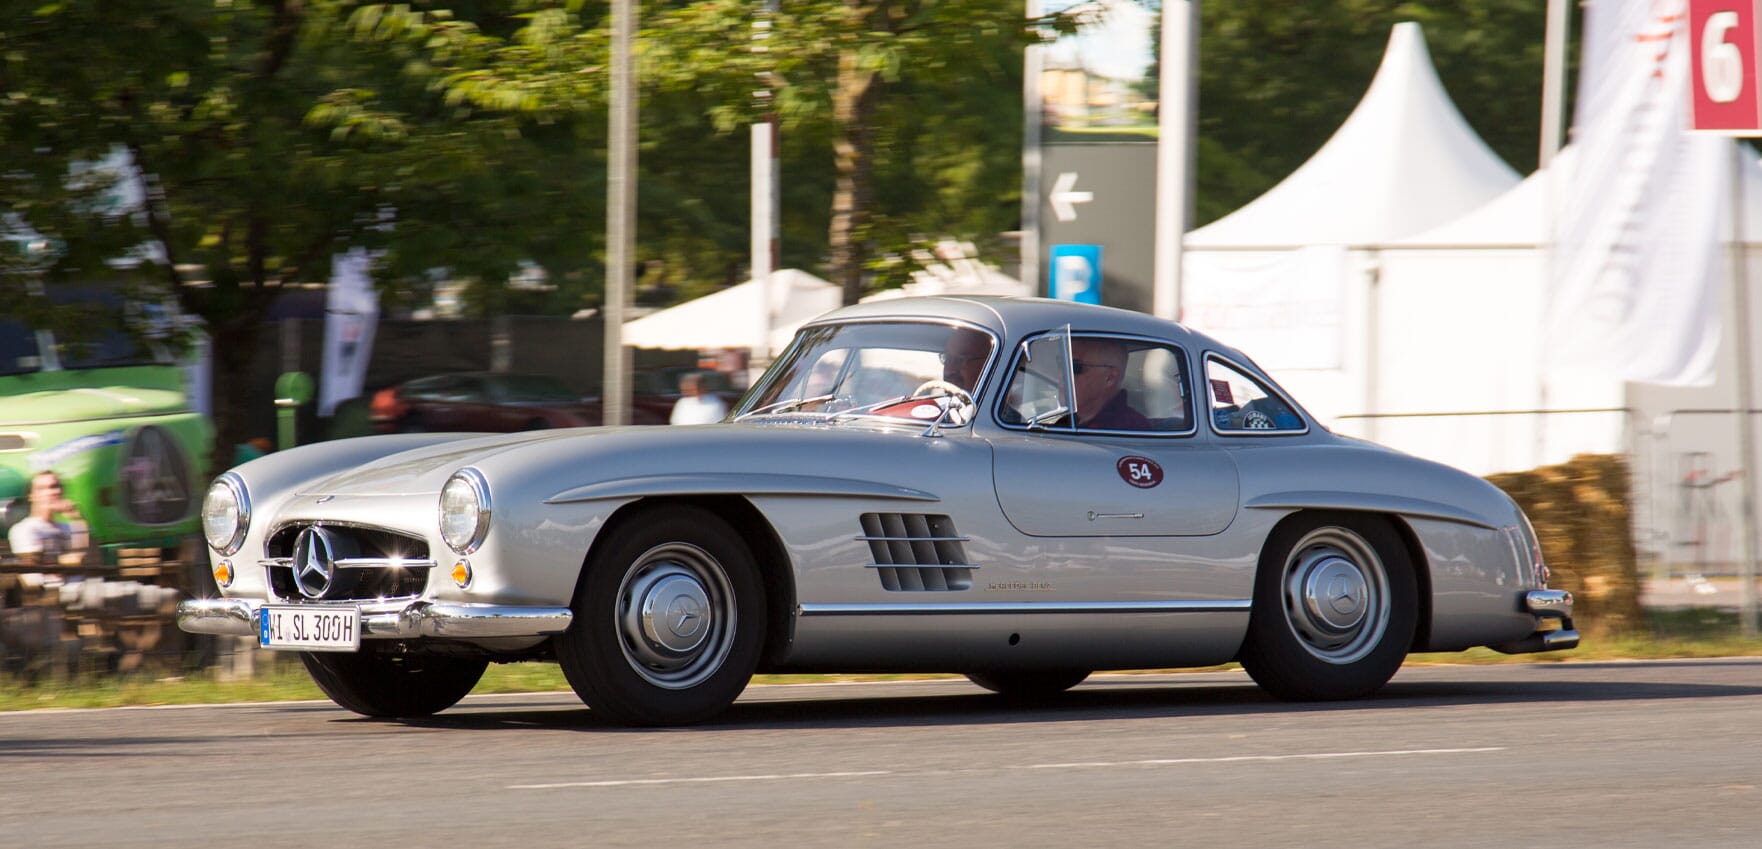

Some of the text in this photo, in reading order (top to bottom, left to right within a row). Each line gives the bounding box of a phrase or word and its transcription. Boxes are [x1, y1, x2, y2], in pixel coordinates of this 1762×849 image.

[1701, 11, 1743, 103] 6
[1055, 255, 1093, 300] P
[1129, 463, 1152, 480] 54
[269, 613, 353, 642] WI SL 300H
